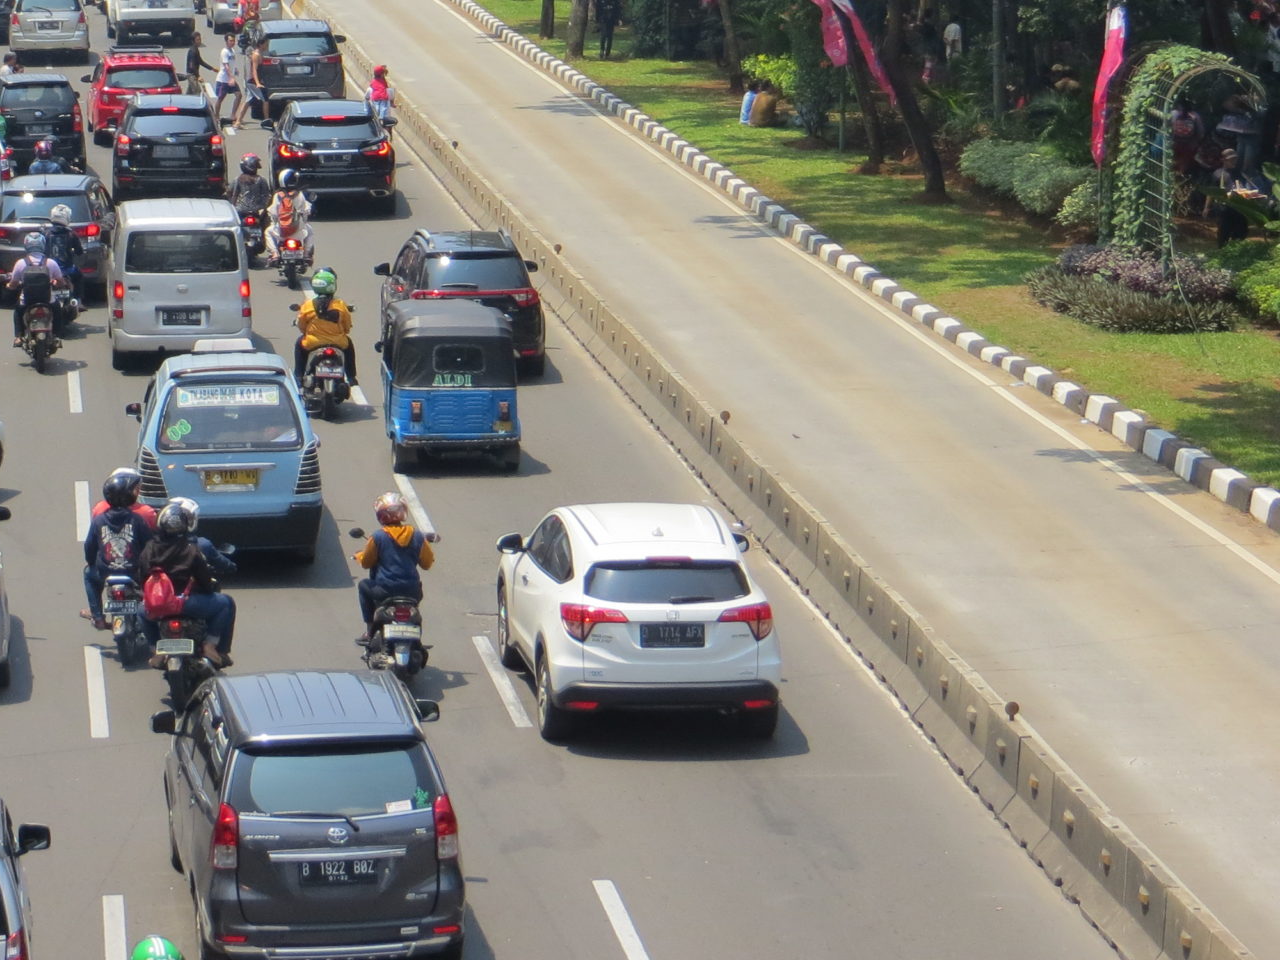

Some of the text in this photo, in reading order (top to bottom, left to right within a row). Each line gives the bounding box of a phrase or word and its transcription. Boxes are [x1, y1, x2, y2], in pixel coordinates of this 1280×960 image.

[432, 374, 472, 387] ALDI
[240, 387, 263, 399] KOTA
[302, 862, 309, 876] B
[320, 861, 345, 875] 1922
